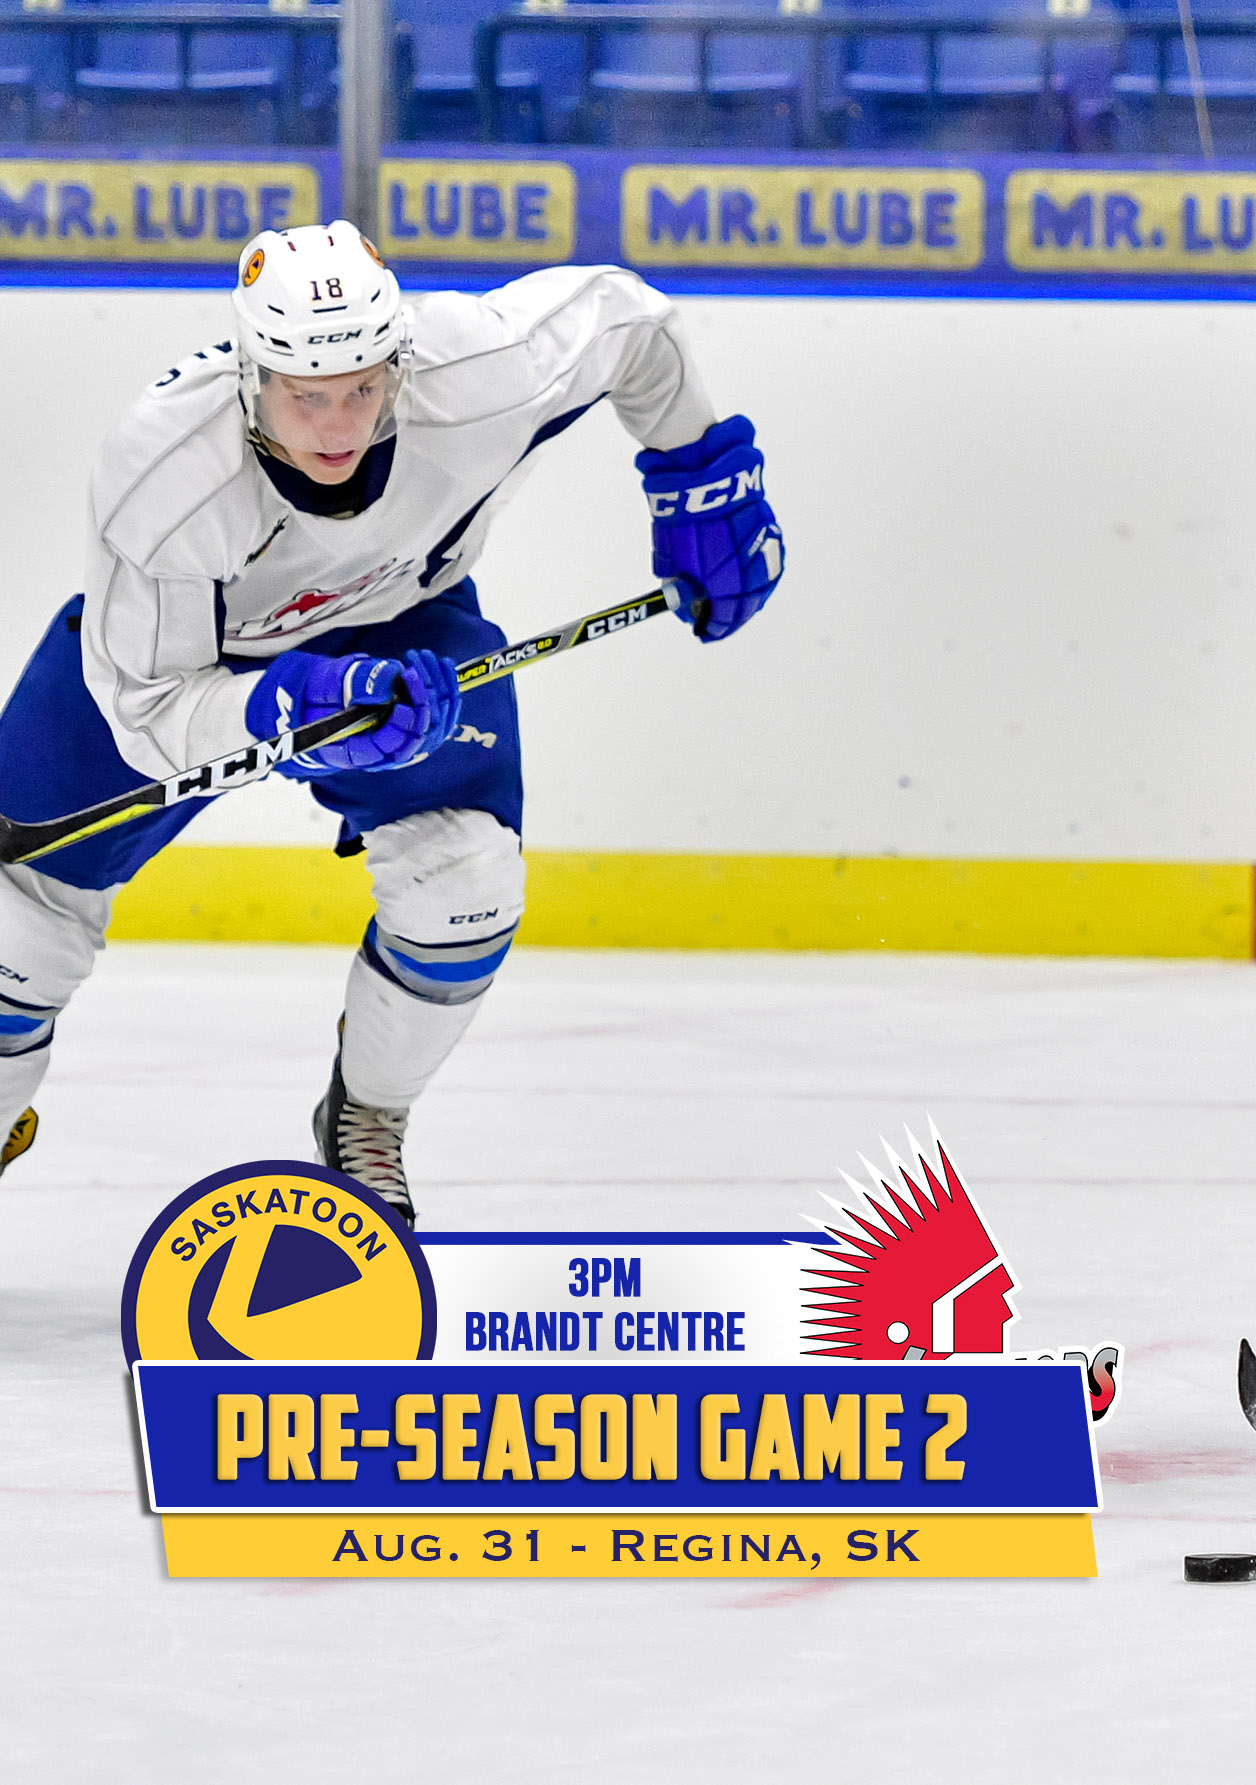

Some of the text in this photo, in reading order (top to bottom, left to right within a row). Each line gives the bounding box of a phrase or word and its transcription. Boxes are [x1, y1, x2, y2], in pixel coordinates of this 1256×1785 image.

[0, 181, 292, 241] MR. LUBE
[389, 182, 548, 240] LUBE
[649, 188, 956, 248] MR. LUBE
[1033, 193, 1256, 251] MR. LU
[310, 277, 343, 301] 18
[307, 327, 363, 345] CCM
[646, 463, 760, 517] CCM
[587, 603, 649, 641] CCM
[488, 641, 538, 674] TACKS
[164, 730, 294, 806] CCM
[448, 907, 499, 926] CCM
[0, 964, 30, 984] CM
